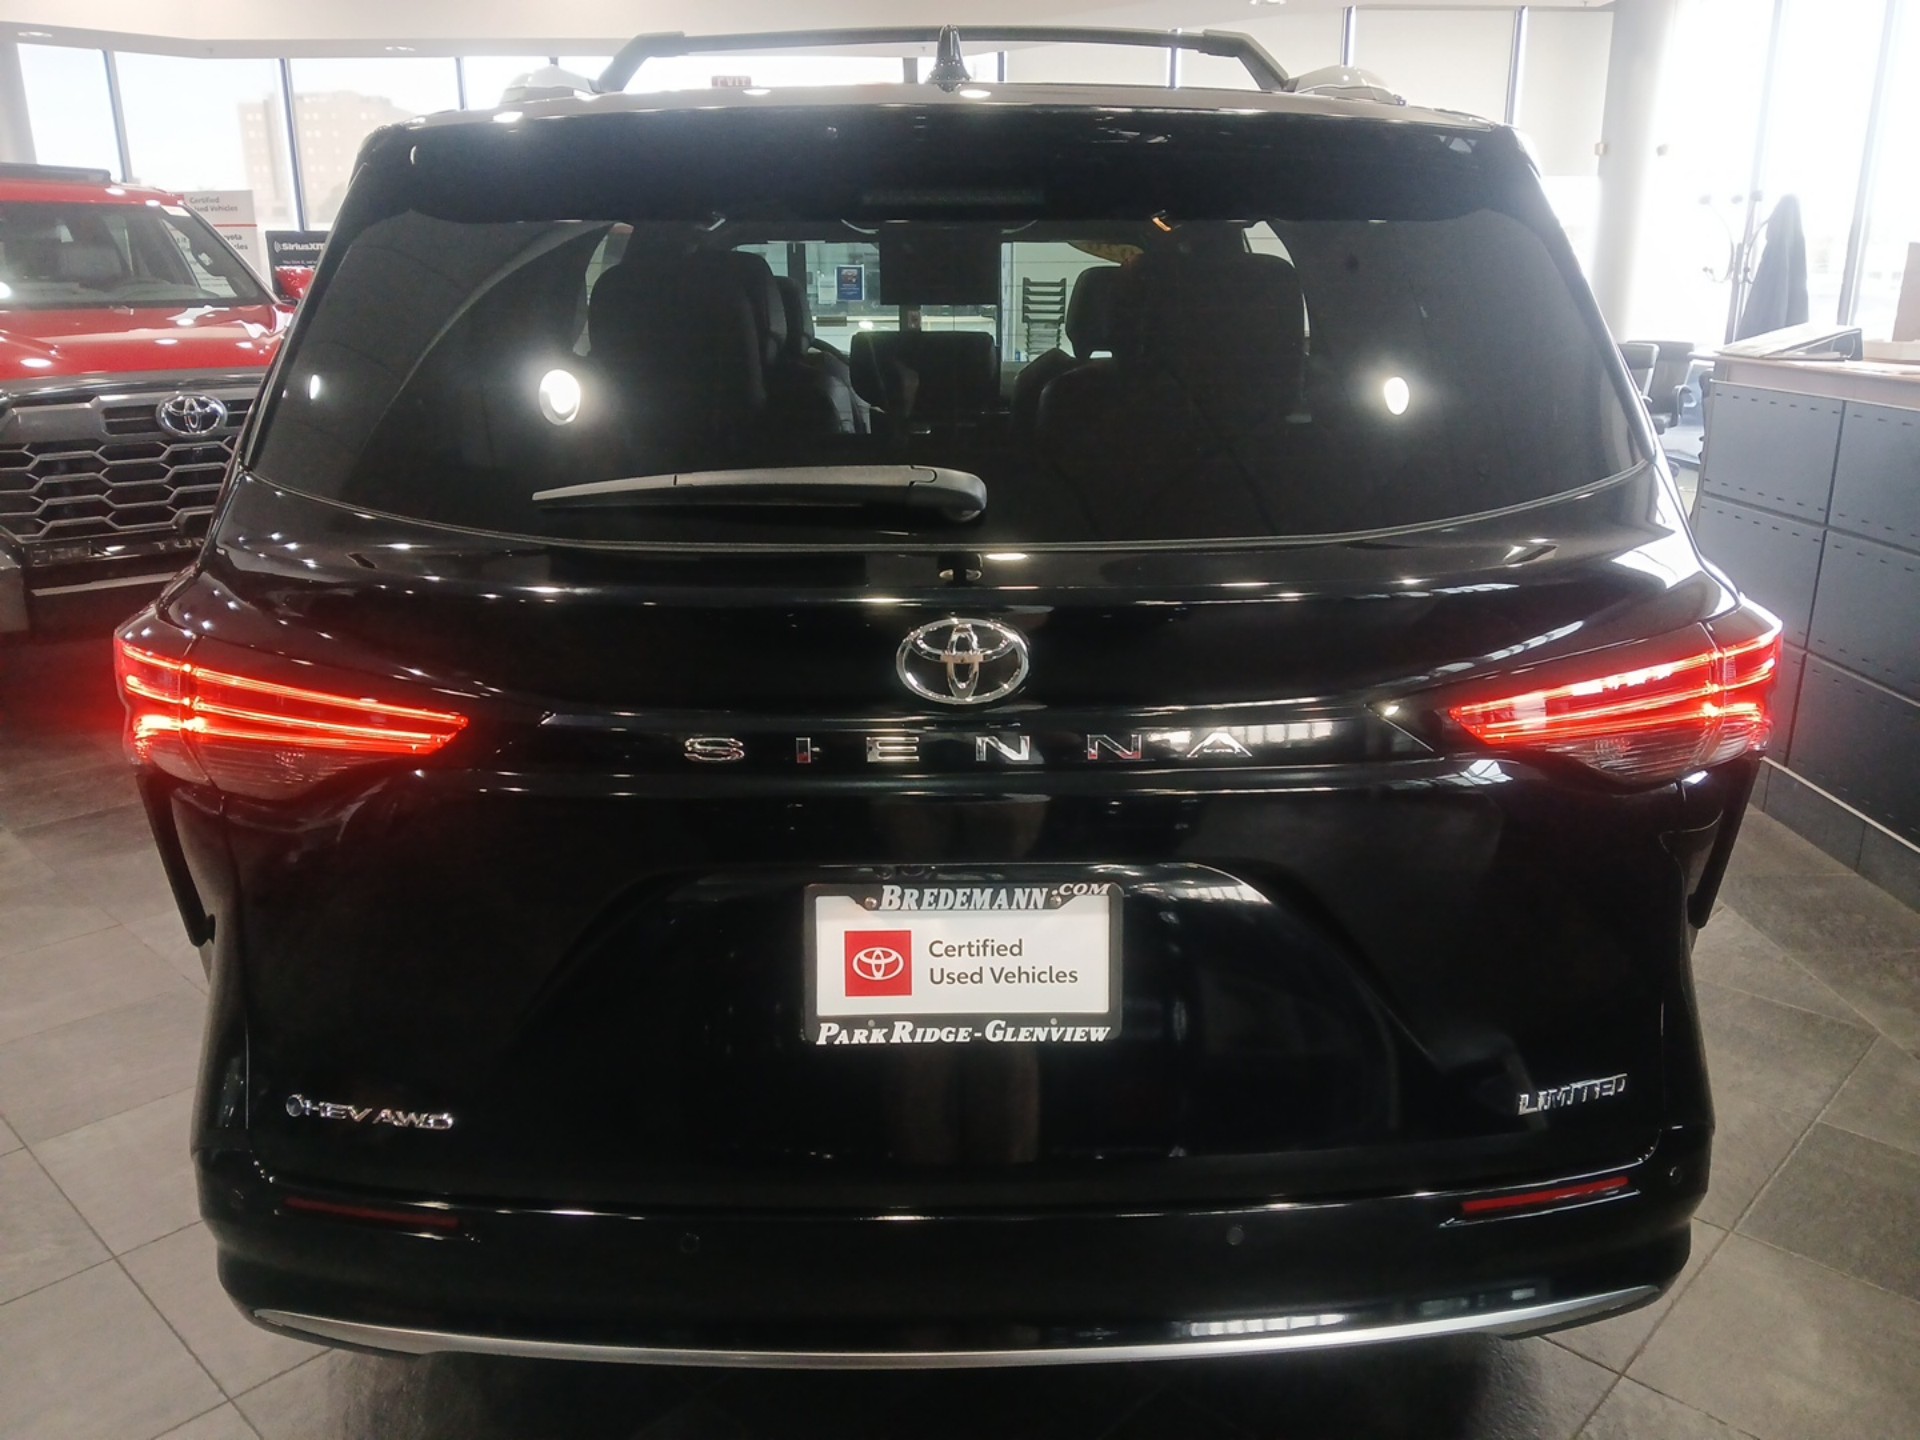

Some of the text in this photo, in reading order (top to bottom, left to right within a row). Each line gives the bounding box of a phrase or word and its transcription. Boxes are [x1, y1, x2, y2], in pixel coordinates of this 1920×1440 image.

[190, 196, 220, 204] Certified
[210, 204, 239, 212] Vehicles
[684, 731, 1254, 763] SIENNA
[928, 938, 1023, 958] Certified
[929, 965, 1079, 985] Used Vehicles
[815, 1021, 888, 1045] PARK
[1518, 1073, 1628, 1115] LIMITED
[303, 1098, 455, 1130] HEV AWD
